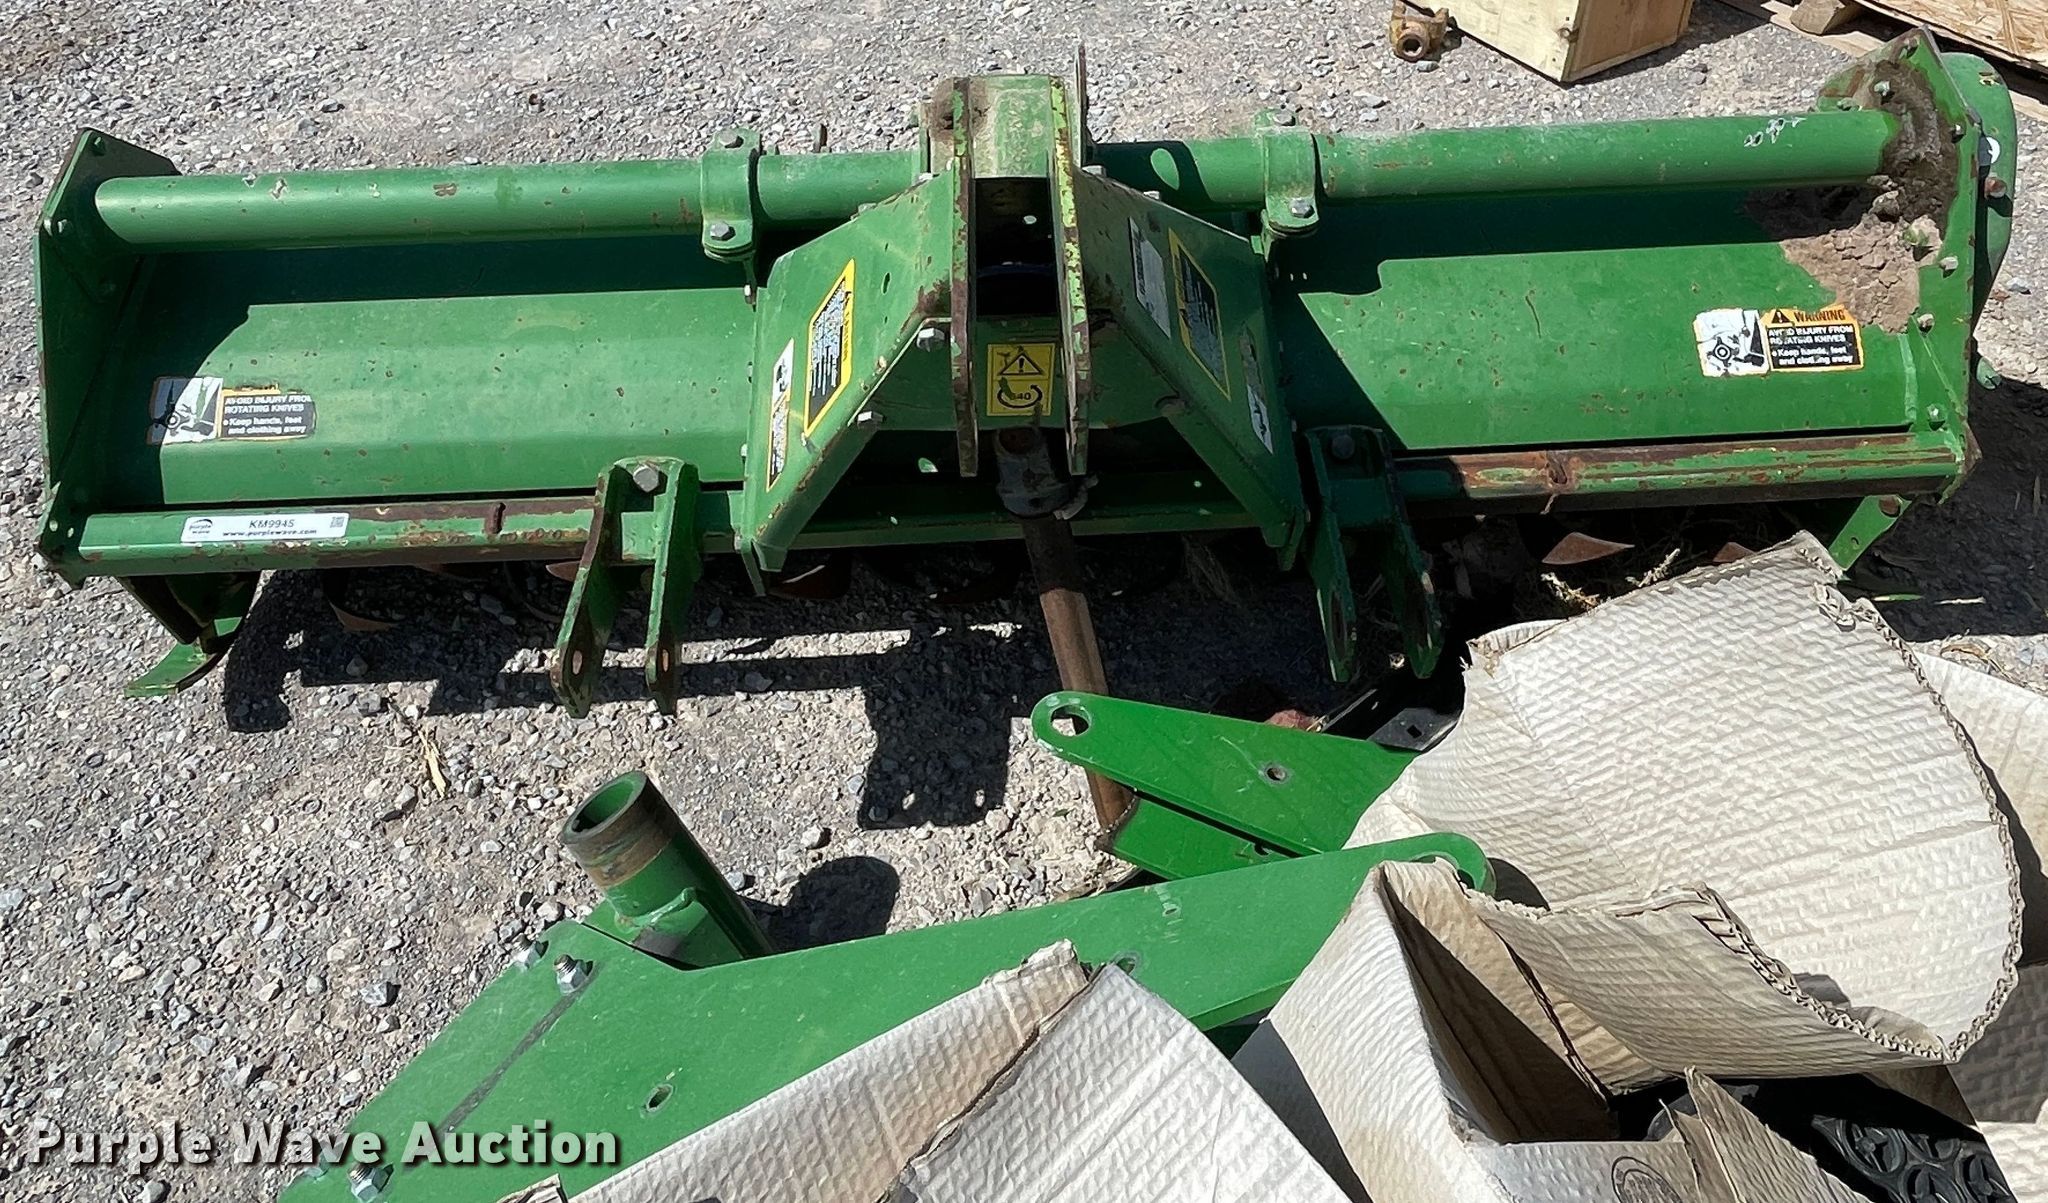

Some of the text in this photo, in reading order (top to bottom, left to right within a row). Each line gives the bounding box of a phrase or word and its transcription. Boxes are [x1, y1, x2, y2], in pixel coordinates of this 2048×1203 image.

[1794, 309, 1846, 322] WARNING
[1768, 325, 1854, 336] AVID INJURY FROM
[1814, 334, 1846, 343] KNIVES
[1778, 349, 1799, 357] Keep
[1830, 346, 1847, 354] feet
[1779, 357, 1795, 365] and
[1832, 355, 1854, 364] away
[254, 395, 288, 404] INJURY
[224, 403, 305, 414] ROTATING KNIVES
[229, 417, 252, 426] Keep
[285, 415, 302, 424] feet
[228, 425, 306, 434] and clothing away
[222, 528, 317, 537] www.purplewave.com
